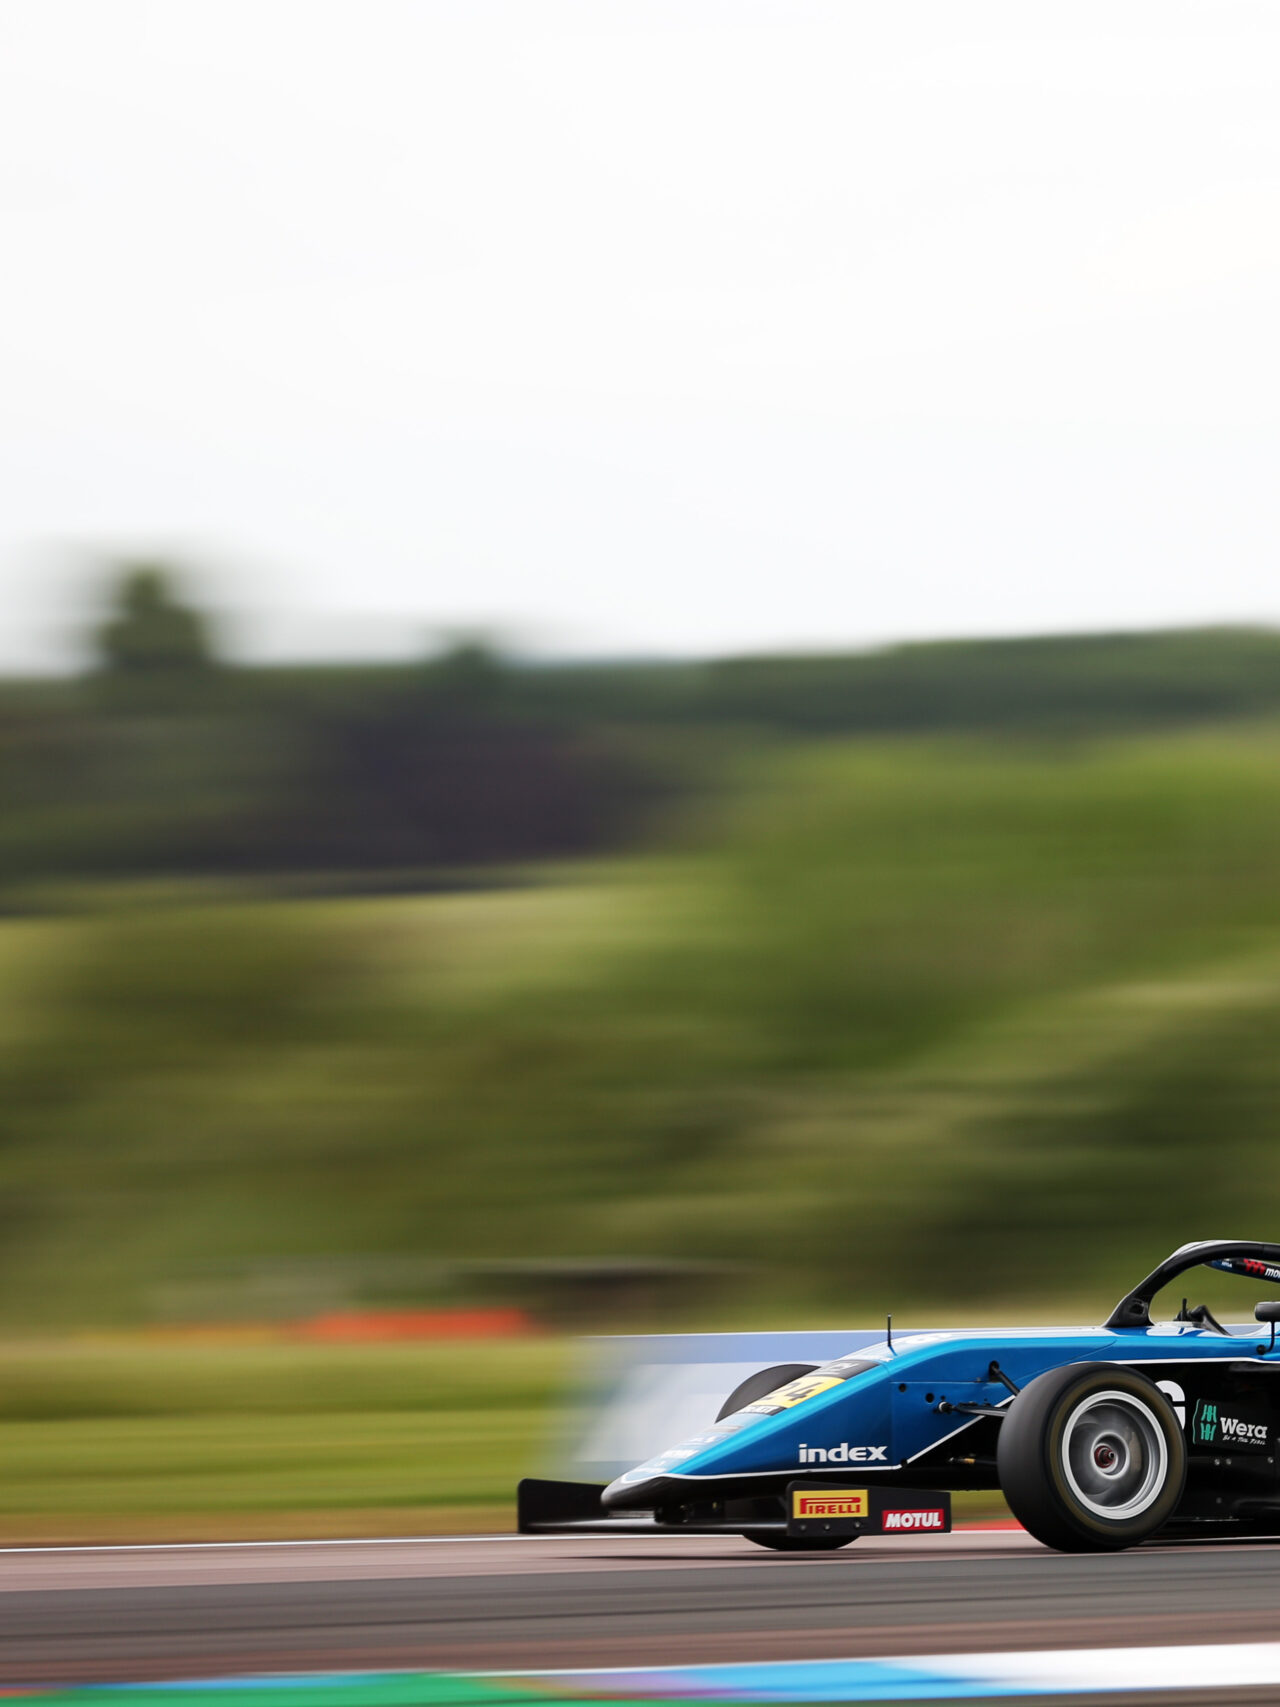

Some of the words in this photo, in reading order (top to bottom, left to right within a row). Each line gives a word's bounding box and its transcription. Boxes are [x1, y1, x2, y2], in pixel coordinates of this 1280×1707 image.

[1220, 1417, 1268, 1439] Wera
[798, 1442, 888, 1463] index
[799, 1497, 862, 1514] PIRELLI
[885, 1512, 942, 1528] MOTUL
